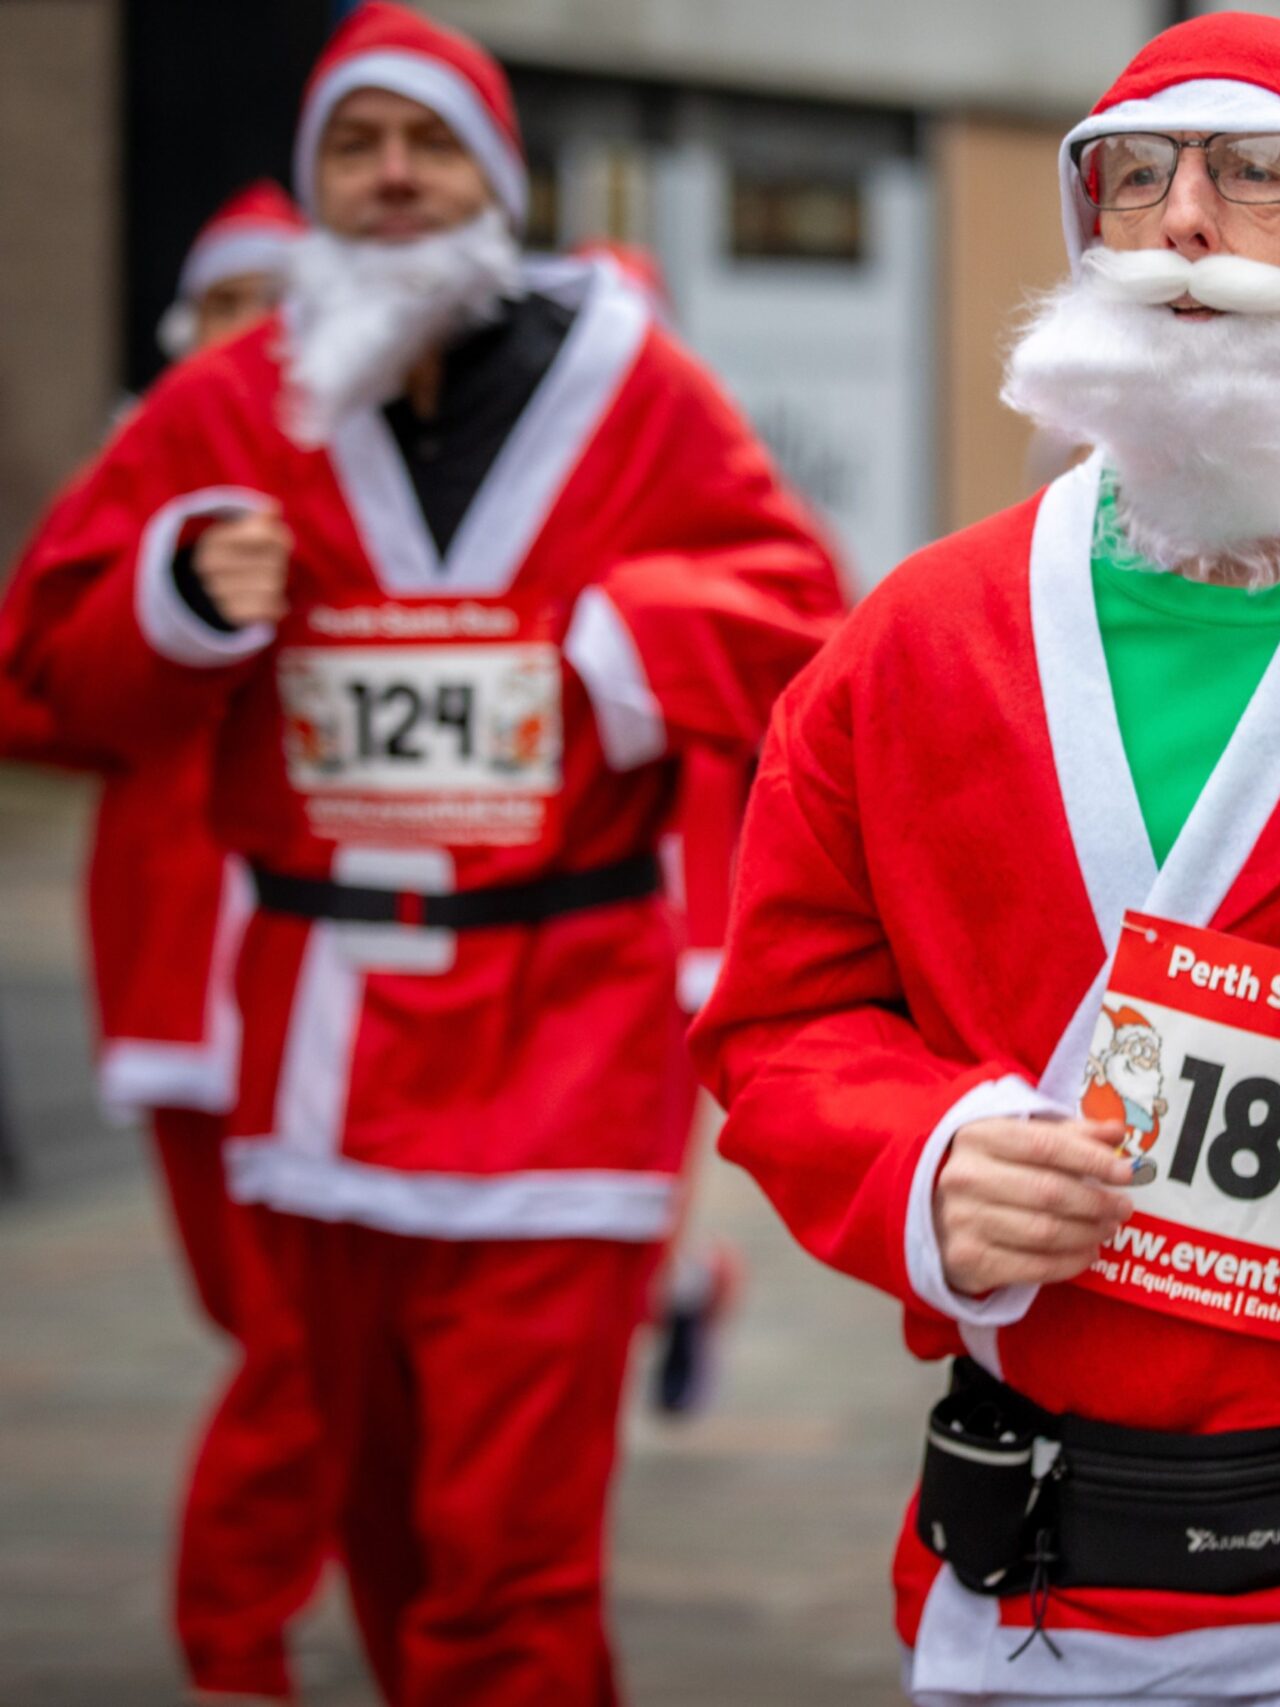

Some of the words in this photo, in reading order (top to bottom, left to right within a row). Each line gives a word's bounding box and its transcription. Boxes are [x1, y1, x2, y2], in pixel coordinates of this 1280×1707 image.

[346, 680, 473, 760] 124
[1167, 945, 1260, 1001] Perth
[1131, 1265, 1232, 1311] Equipment
